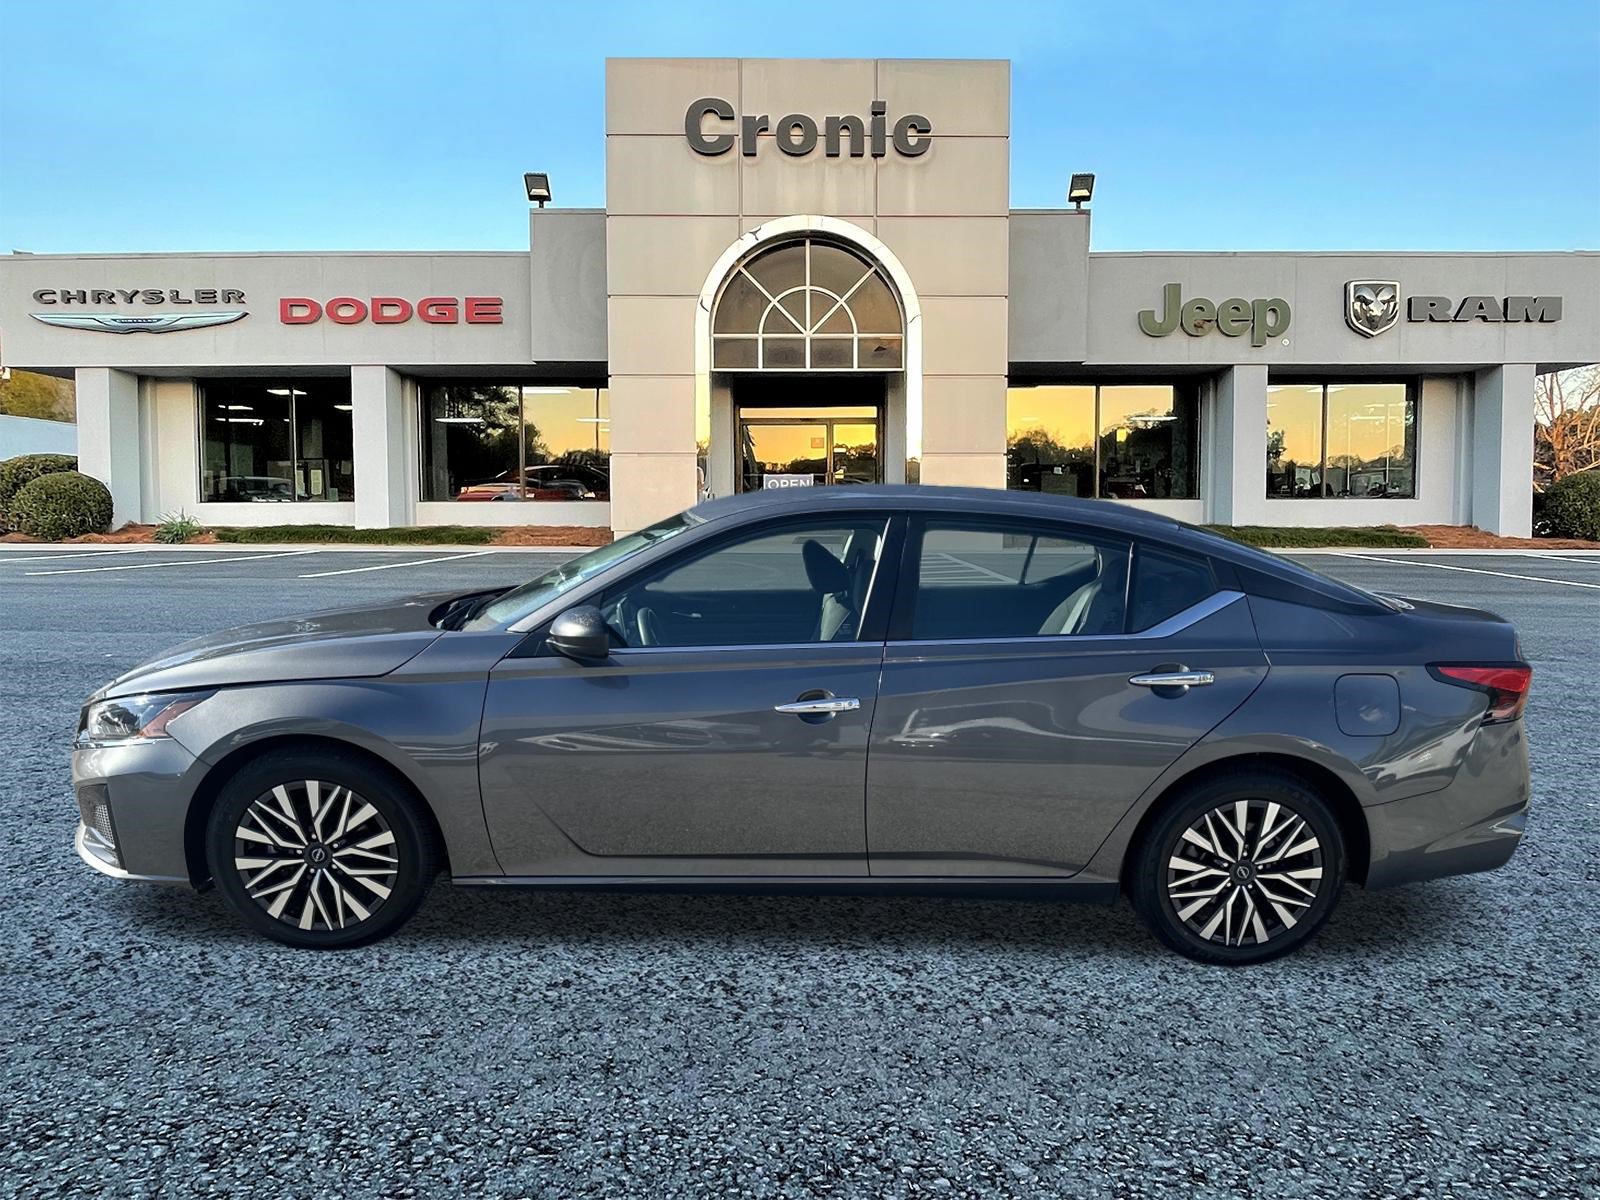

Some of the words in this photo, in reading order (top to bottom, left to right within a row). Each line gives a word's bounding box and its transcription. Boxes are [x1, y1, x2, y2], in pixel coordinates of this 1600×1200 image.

[684, 97, 932, 158] Cronic
[32, 289, 247, 304] CHRYSLER
[1408, 296, 1563, 322] RAM
[280, 296, 504, 325] DODGE
[1138, 283, 1291, 347] Jeep
[768, 479, 811, 489] OPEN
